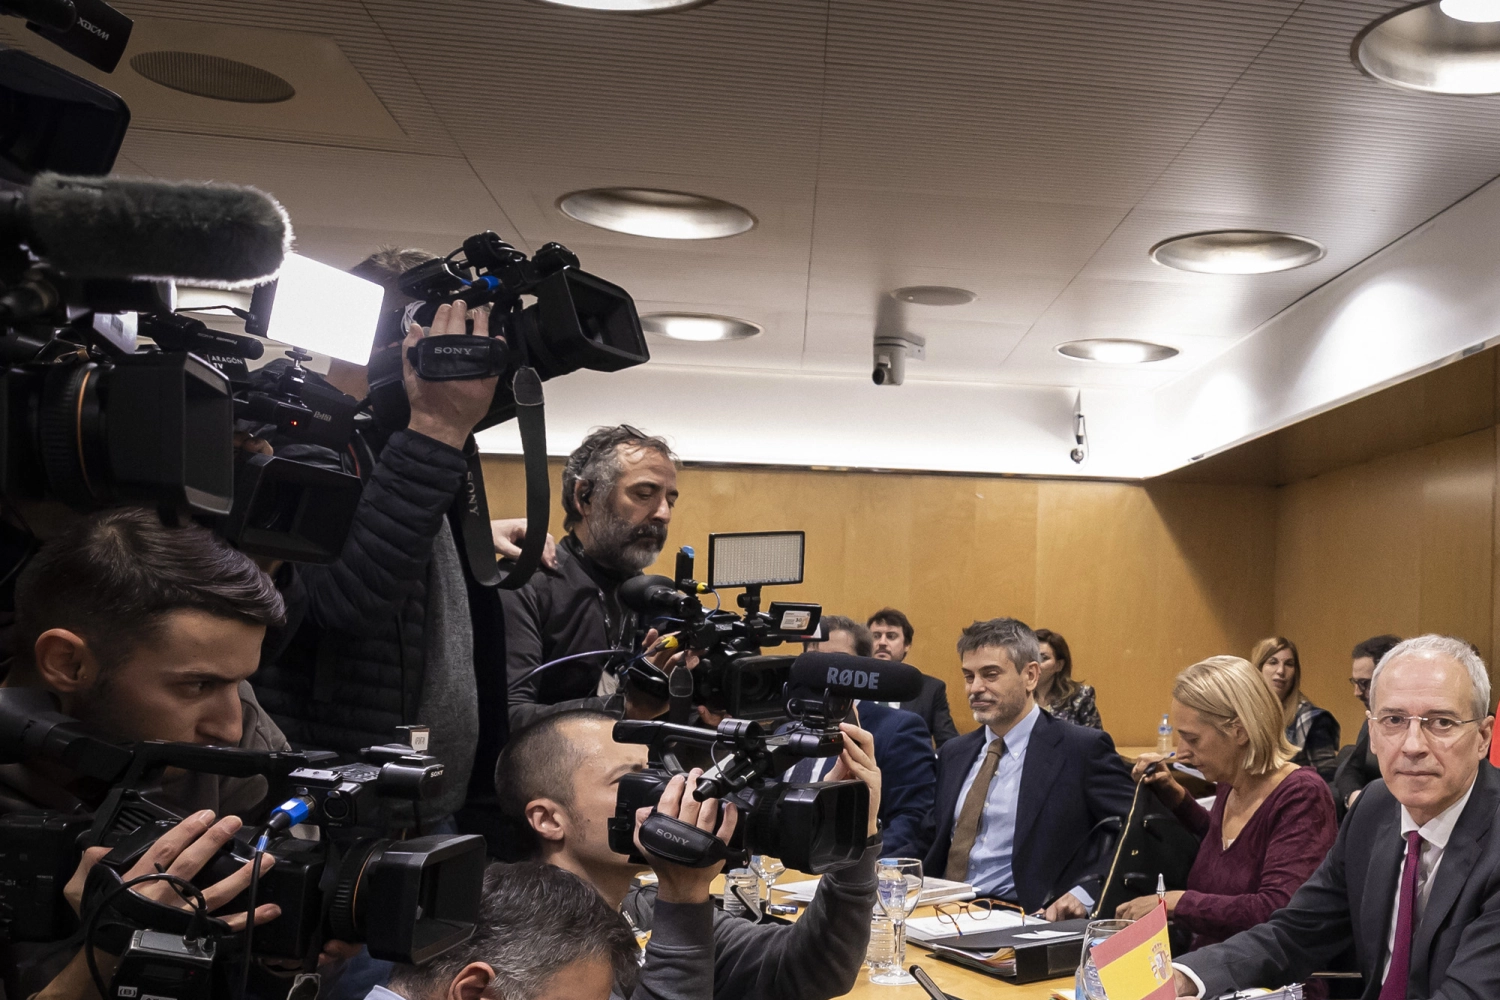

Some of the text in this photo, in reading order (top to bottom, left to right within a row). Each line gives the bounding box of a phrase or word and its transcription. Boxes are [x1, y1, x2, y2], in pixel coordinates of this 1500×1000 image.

[77, 16, 110, 41] XDCAM
[434, 346, 473, 356] SONY
[466, 471, 479, 517] SONY
[827, 667, 880, 690] RØDE
[655, 828, 690, 847] SONY
[119, 989, 137, 998] (B)
